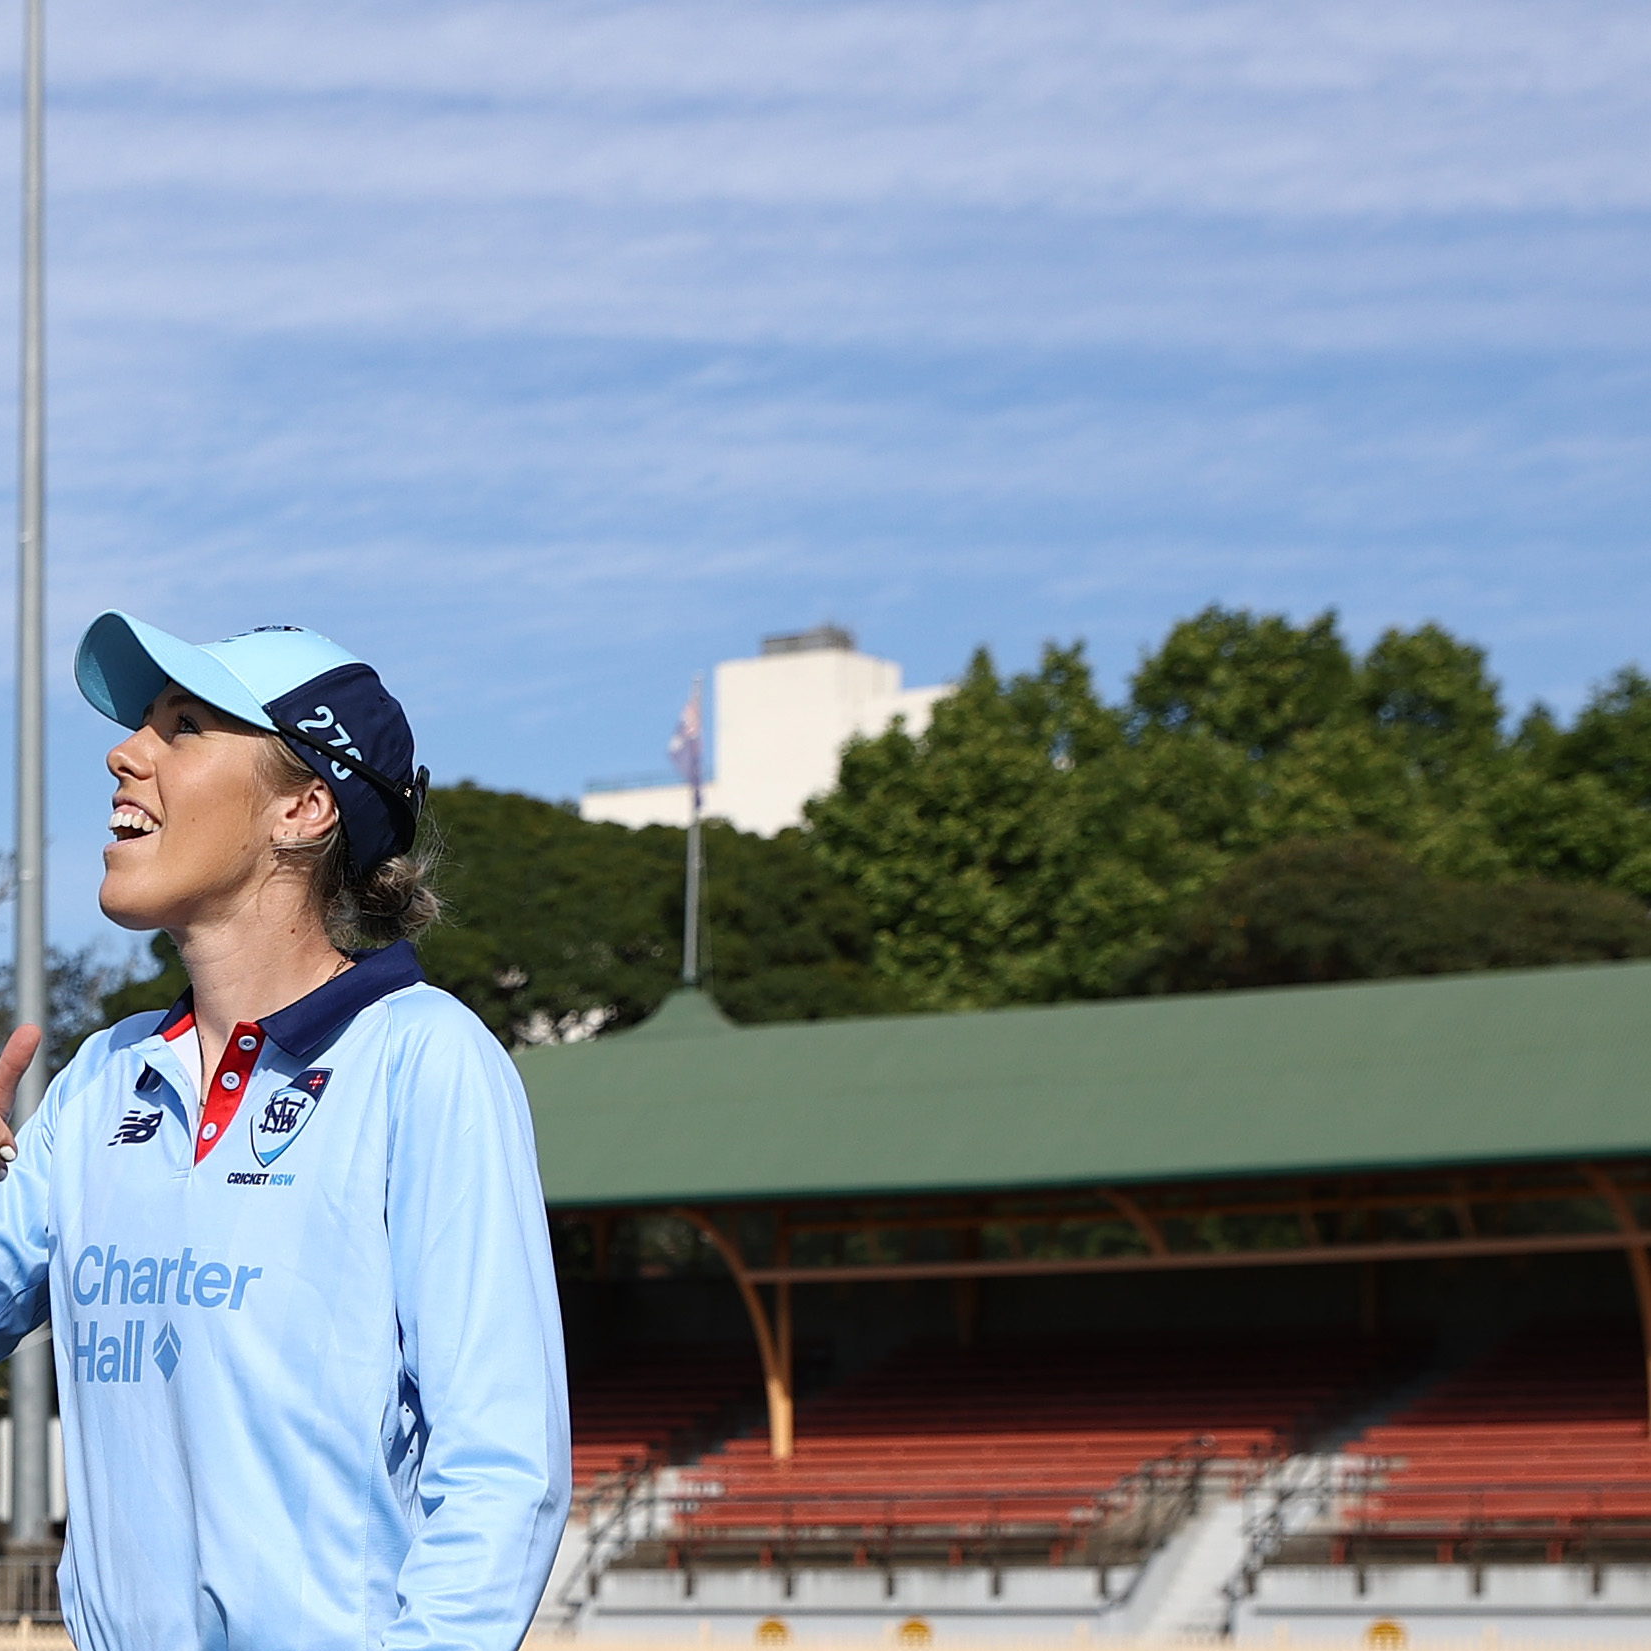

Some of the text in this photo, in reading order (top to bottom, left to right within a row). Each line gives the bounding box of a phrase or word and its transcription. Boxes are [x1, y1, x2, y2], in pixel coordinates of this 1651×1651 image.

[227, 1172, 296, 1186] CRICKET NSW
[73, 1245, 263, 1311] Charter
[74, 1320, 145, 1383] Hall
